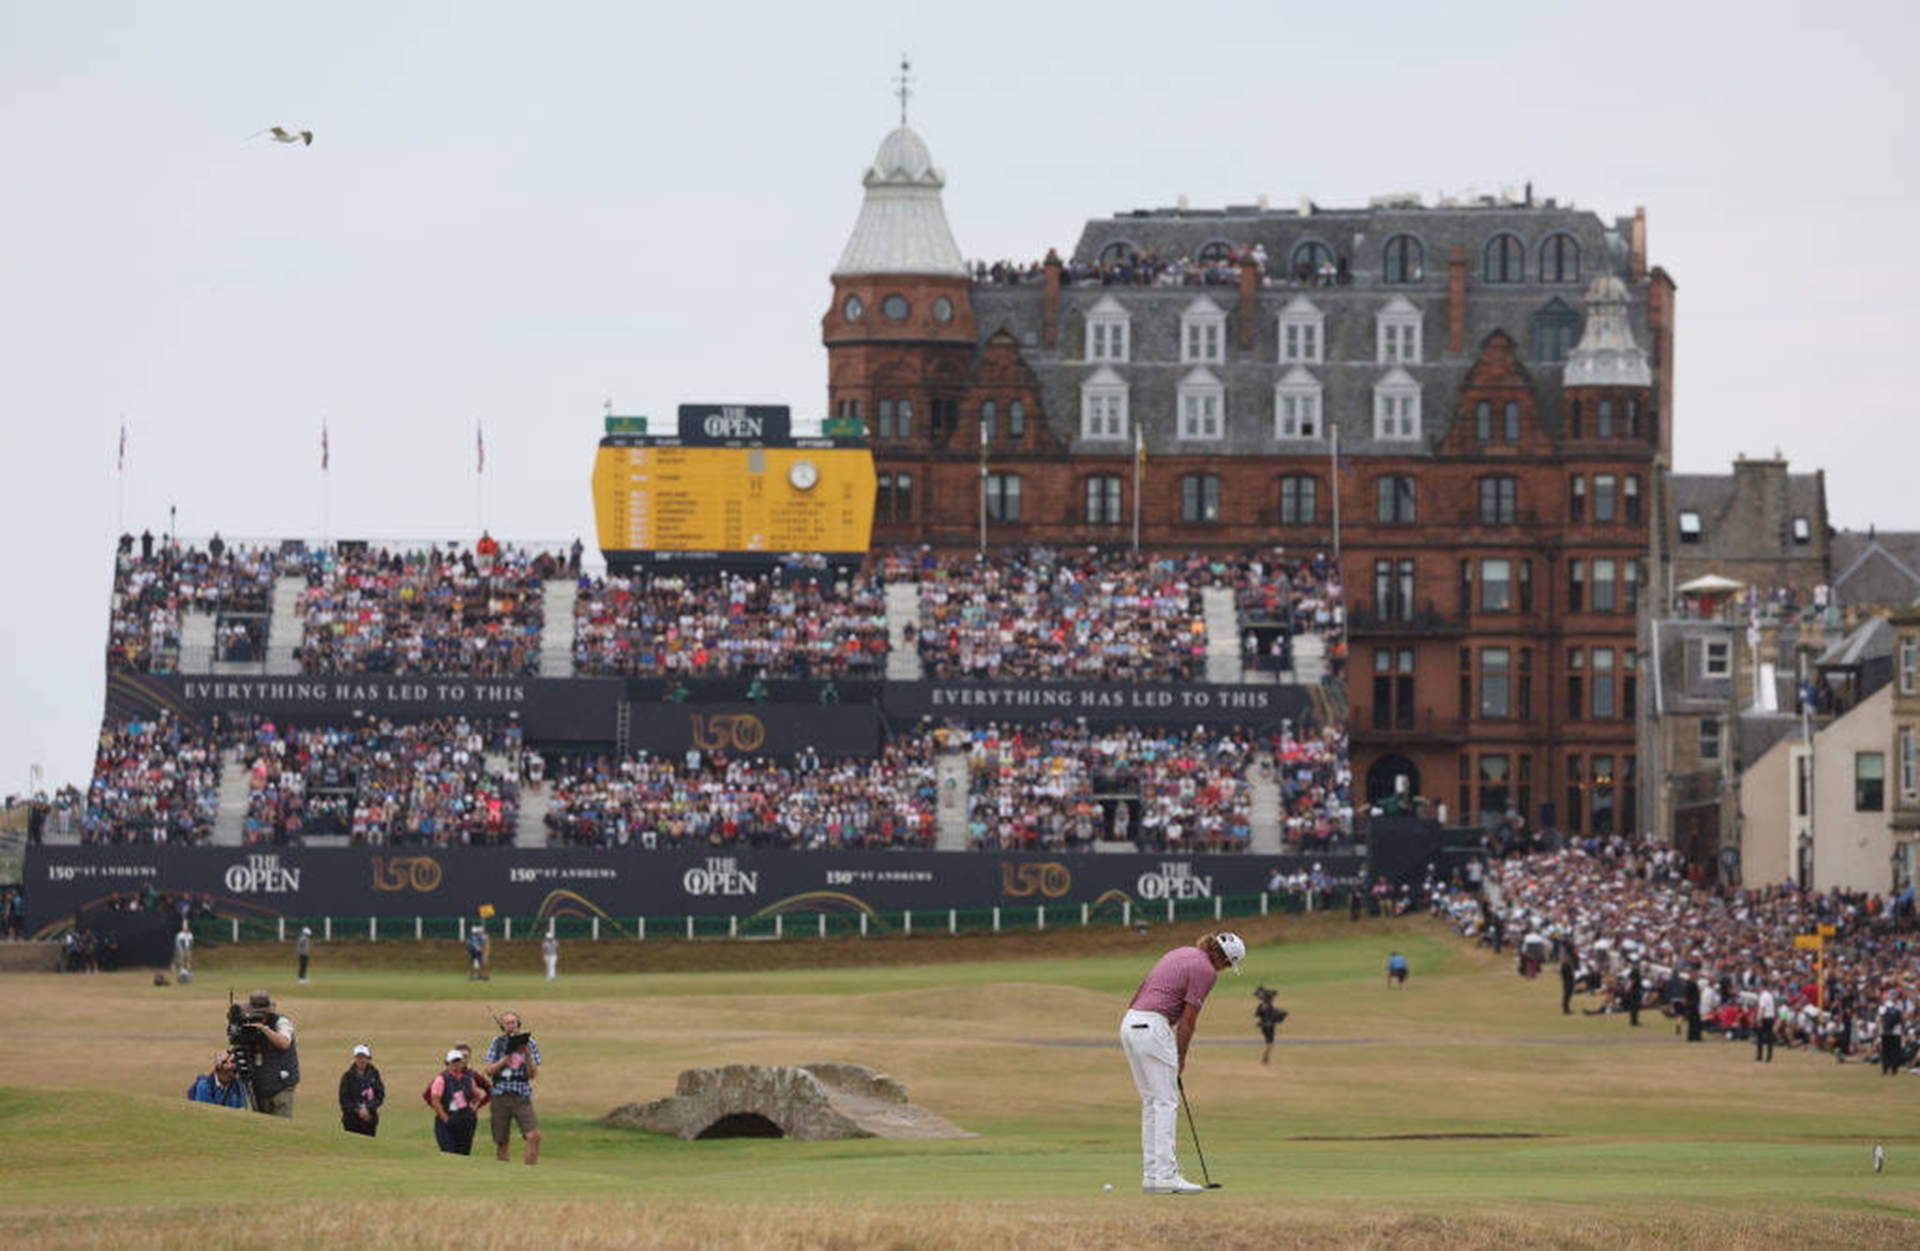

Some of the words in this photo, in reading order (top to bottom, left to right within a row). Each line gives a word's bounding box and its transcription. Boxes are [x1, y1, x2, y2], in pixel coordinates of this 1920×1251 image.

[723, 406, 747, 420] THE
[704, 414, 763, 437] OPEN
[184, 682, 327, 699] EVERYTHING
[336, 683, 378, 700] HAS
[388, 684, 428, 700] LED
[437, 684, 465, 700] TO
[474, 685, 524, 701] THIS
[932, 688, 1073, 706] EVERYTHING
[1081, 690, 1124, 706] HAS
[1132, 690, 1173, 707] LED
[1181, 691, 1210, 707] TO
[1218, 692, 1269, 708] THIS
[690, 713, 765, 751] 150
[102, 867, 157, 876] ANDREWS
[248, 854, 280, 871] THE
[706, 857, 737, 874] THE
[1161, 862, 1192, 877] THE
[225, 865, 300, 892] OPEN
[372, 856, 442, 892] 150
[561, 868, 616, 878] ANDREWS
[683, 868, 758, 895] OPEN
[877, 871, 933, 881] ANDREWS
[1001, 861, 1071, 898] 150
[1137, 872, 1213, 899] OPEN
